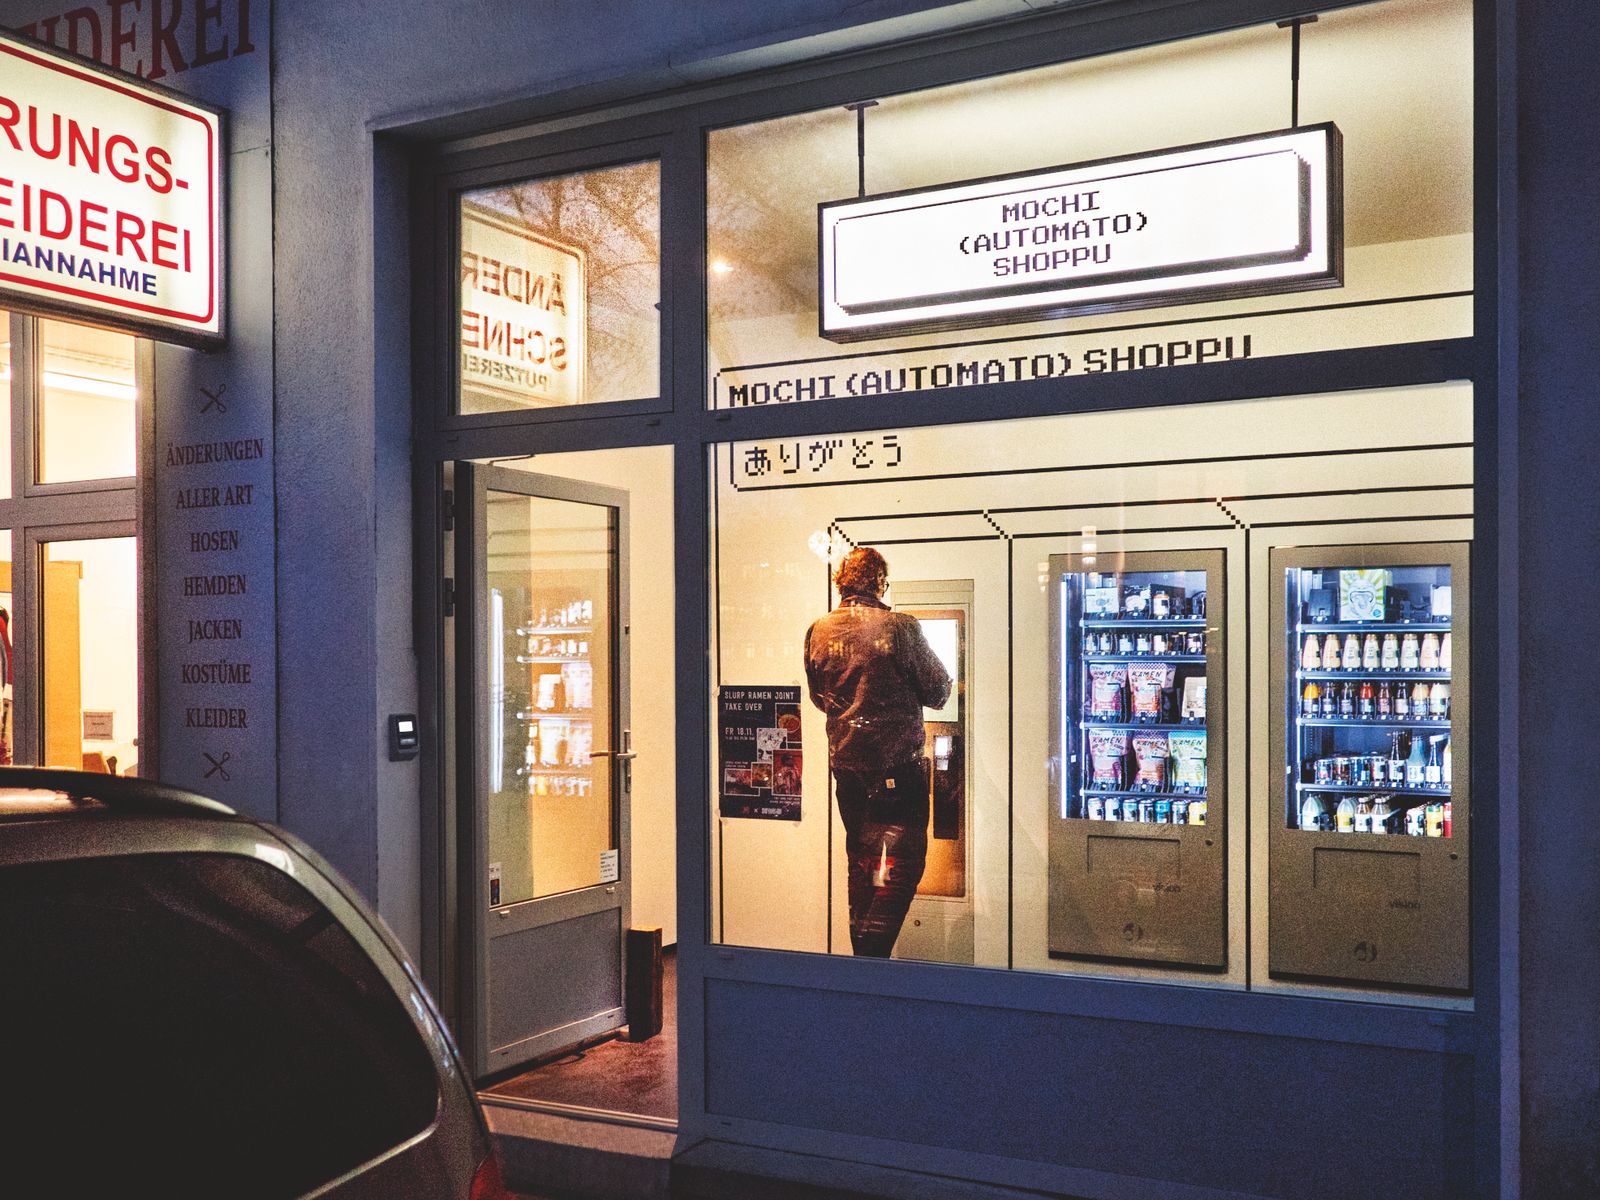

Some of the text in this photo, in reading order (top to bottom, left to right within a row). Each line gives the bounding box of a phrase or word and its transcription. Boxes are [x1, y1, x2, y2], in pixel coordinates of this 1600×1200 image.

[0, 95, 189, 194] RUNGS-
[1002, 191, 1100, 223] MOCHI
[960, 212, 1147, 255] (AUTOMATO)
[993, 244, 1111, 277] SHOPPU
[729, 335, 1251, 407] MOCHI (AUTOMATO) SHOPPU
[166, 438, 264, 467] ÄNDERUNGEN
[745, 435, 901, 476] ありがとう
[176, 484, 254, 509] ALLER ART
[190, 530, 239, 552] HOSEN
[184, 575, 246, 596] HEMDEN
[188, 620, 242, 643] JACKEN
[182, 660, 251, 684] KOSTÜME
[724, 691, 795, 700] SLURP RAMEN JOINT
[725, 702, 763, 711] TAKE OVER
[186, 709, 248, 728] KLEIDER
[725, 727, 734, 736] FR
